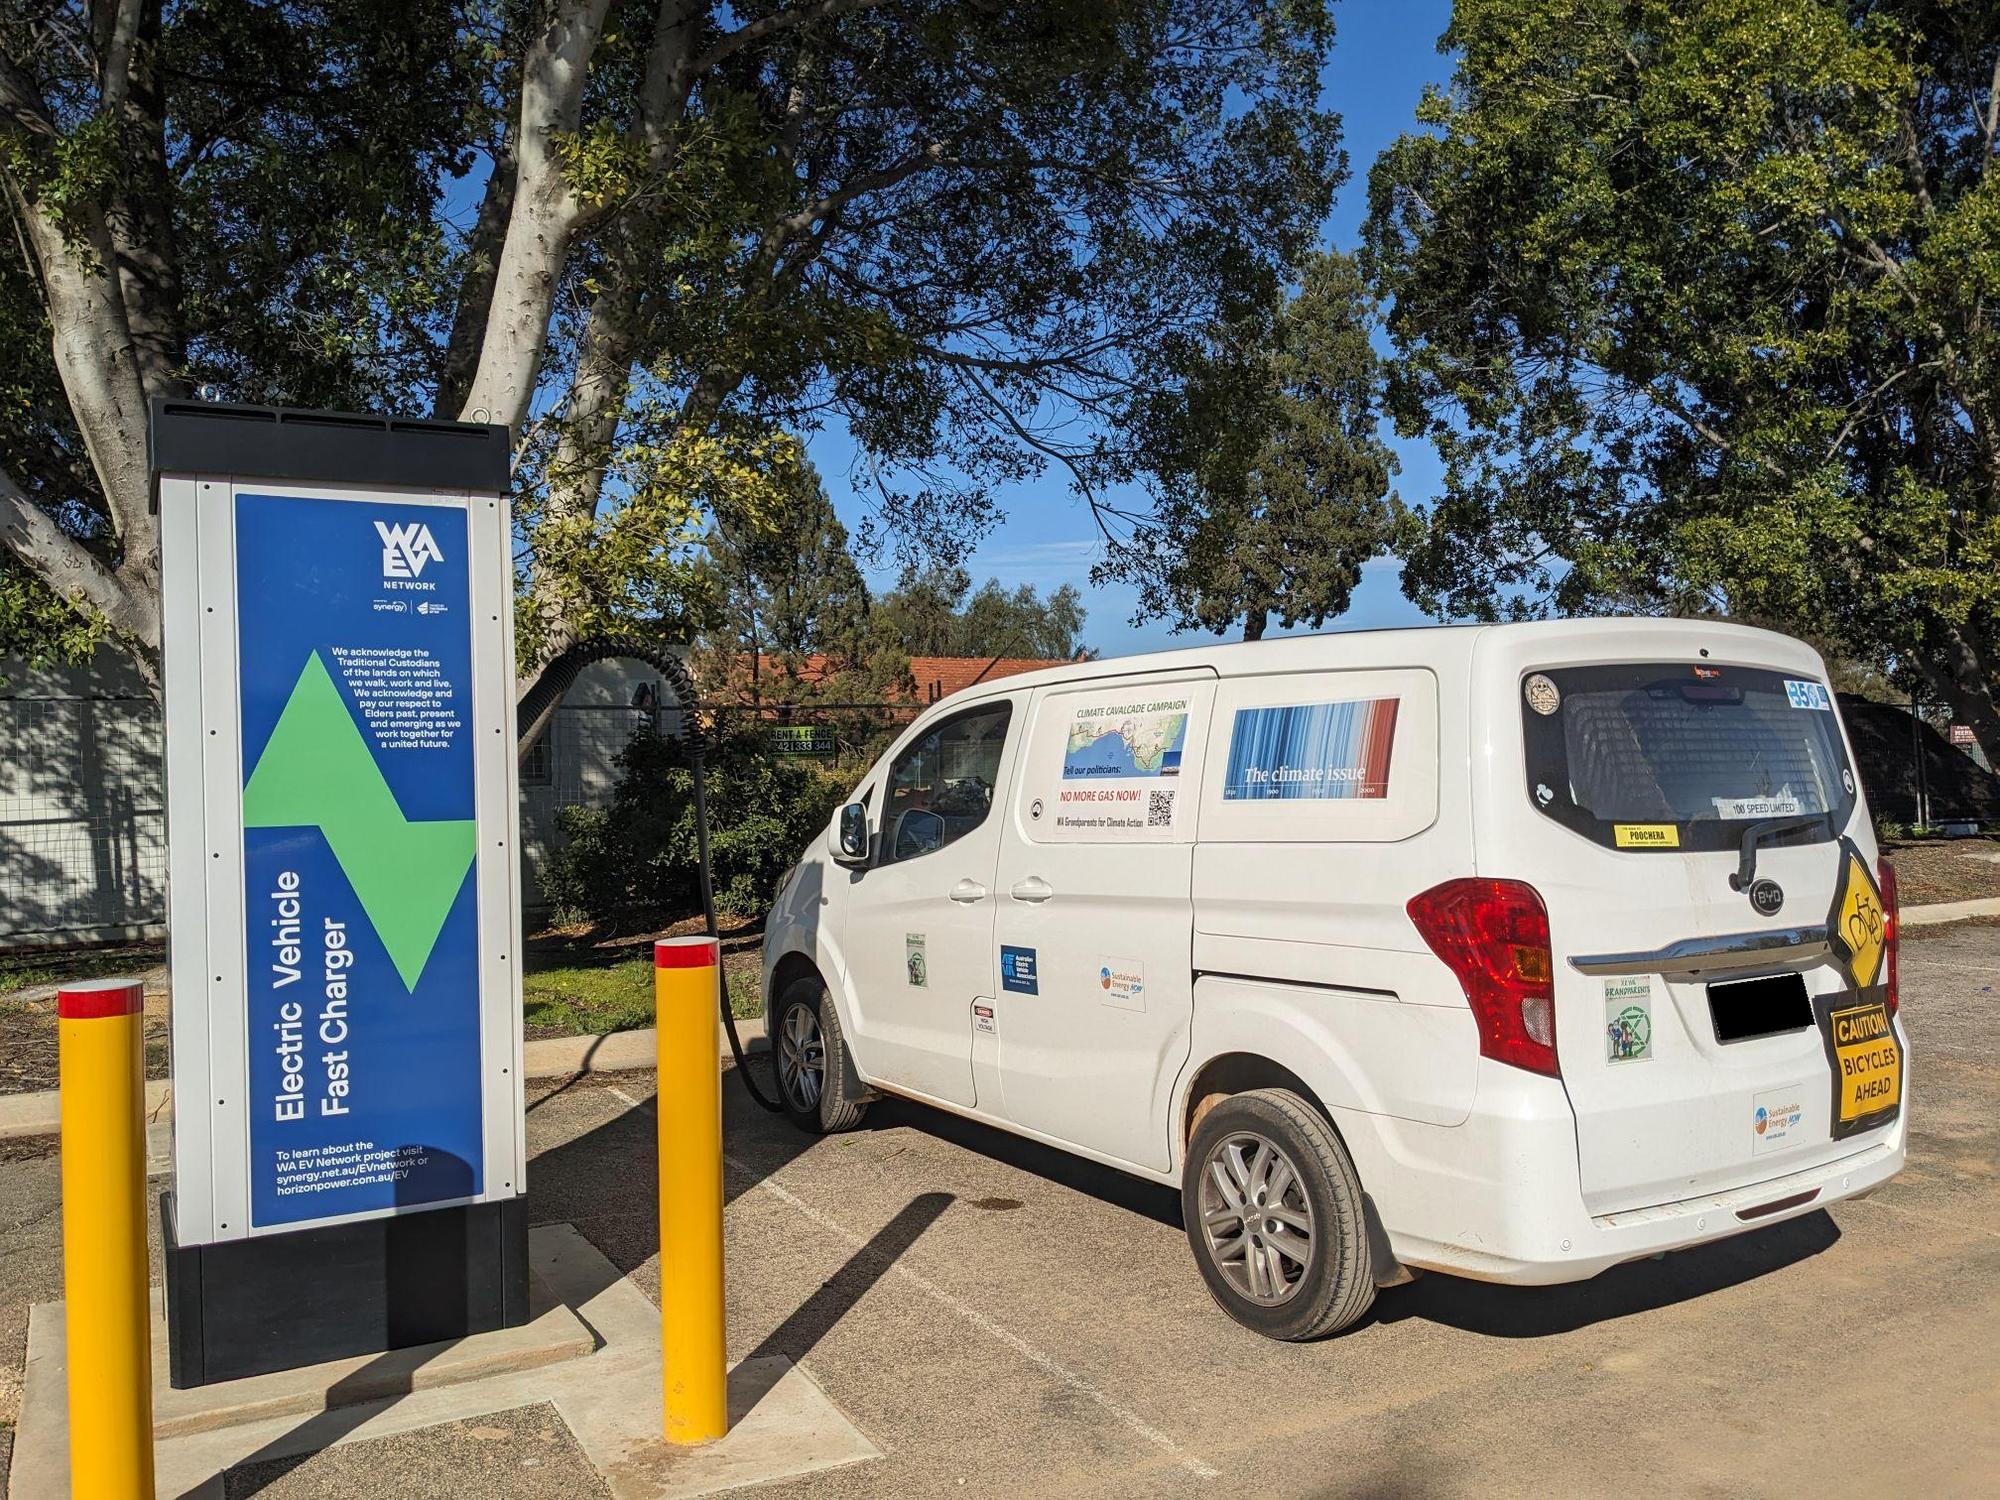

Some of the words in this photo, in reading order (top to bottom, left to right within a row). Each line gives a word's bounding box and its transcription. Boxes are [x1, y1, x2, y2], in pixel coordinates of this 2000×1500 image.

[383, 581, 436, 590] NETWORK
[373, 602, 404, 612] synergy
[332, 648, 348, 656] We
[350, 648, 412, 658] acknowledge
[414, 649, 429, 657] the
[338, 658, 386, 666] Traditional
[388, 659, 440, 668] Custodians
[343, 668, 353, 676] of
[372, 669, 397, 677] lands
[414, 680, 432, 688] and
[434, 680, 452, 688] live.
[354, 689, 370, 697] We
[372, 689, 433, 699] acknowledge
[435, 690, 452, 698] and
[360, 701, 376, 709] pay
[396, 700, 430, 709] respect
[432, 700, 441, 708] to
[1077, 708, 1105, 718] CLIMATE
[1106, 704, 1145, 716] CAVALCADE
[1147, 700, 1187, 712] CAMPAIGN
[365, 710, 394, 718] Elders
[420, 710, 455, 718] present
[370, 720, 387, 728] and
[390, 720, 434, 729] emerging
[376, 730, 398, 738] work
[400, 730, 440, 739] together
[771, 730, 793, 739] RENT
[796, 730, 801, 738] A
[805, 730, 831, 739] FENCE
[389, 740, 418, 748] united
[420, 740, 450, 748] future.
[814, 741, 831, 750] 344
[1064, 766, 1074, 775] Tell
[1086, 766, 1122, 776] politicians:
[1245, 768, 1268, 782] The
[1272, 766, 1324, 782] climate
[1328, 764, 1366, 780] issue
[1060, 791, 1072, 801] NO
[1073, 791, 1097, 801] MORE
[1098, 790, 1115, 801] GAS
[1116, 789, 1141, 801] NOW!
[1746, 804, 1769, 814] SPEED
[1770, 803, 1795, 813] LIMITED
[1065, 816, 1097, 828] Grandparents
[1098, 817, 1106, 827] for
[1107, 817, 1125, 827] Climate
[1127, 817, 1143, 828] Action
[1630, 831, 1665, 840] POOCHERA
[1758, 890, 1781, 904] BYD
[271, 871, 301, 989] Vehicle
[319, 917, 353, 1044] Charger
[1112, 972, 1142, 983] Sustainable
[1112, 980, 1129, 991] Energy
[1605, 985, 1650, 996] GRANDPARENTS
[1838, 1012, 1886, 1042] CAUTION
[273, 1002, 304, 1121] Electric
[1843, 1048, 1895, 1076] BICYCLES
[321, 1050, 349, 1116] Fast
[1854, 1077, 1891, 1103] AHEAD
[1769, 1103, 1800, 1118] Sustainable
[1769, 1118, 1787, 1128] Energy
[276, 1152, 290, 1161] To
[292, 1149, 320, 1159] learn
[322, 1144, 353, 1156] about
[355, 1141, 373, 1151] the
[277, 1162, 296, 1172] WA
[299, 1160, 314, 1170] EV
[316, 1154, 362, 1168] Network
[364, 1149, 400, 1163] project
[402, 1146, 423, 1156] visit
[277, 1158, 415, 1185] synergy.net.au/EVnetwork
[417, 1157, 428, 1166] or
[277, 1170, 409, 1196] horizonpower.com.au/EV
